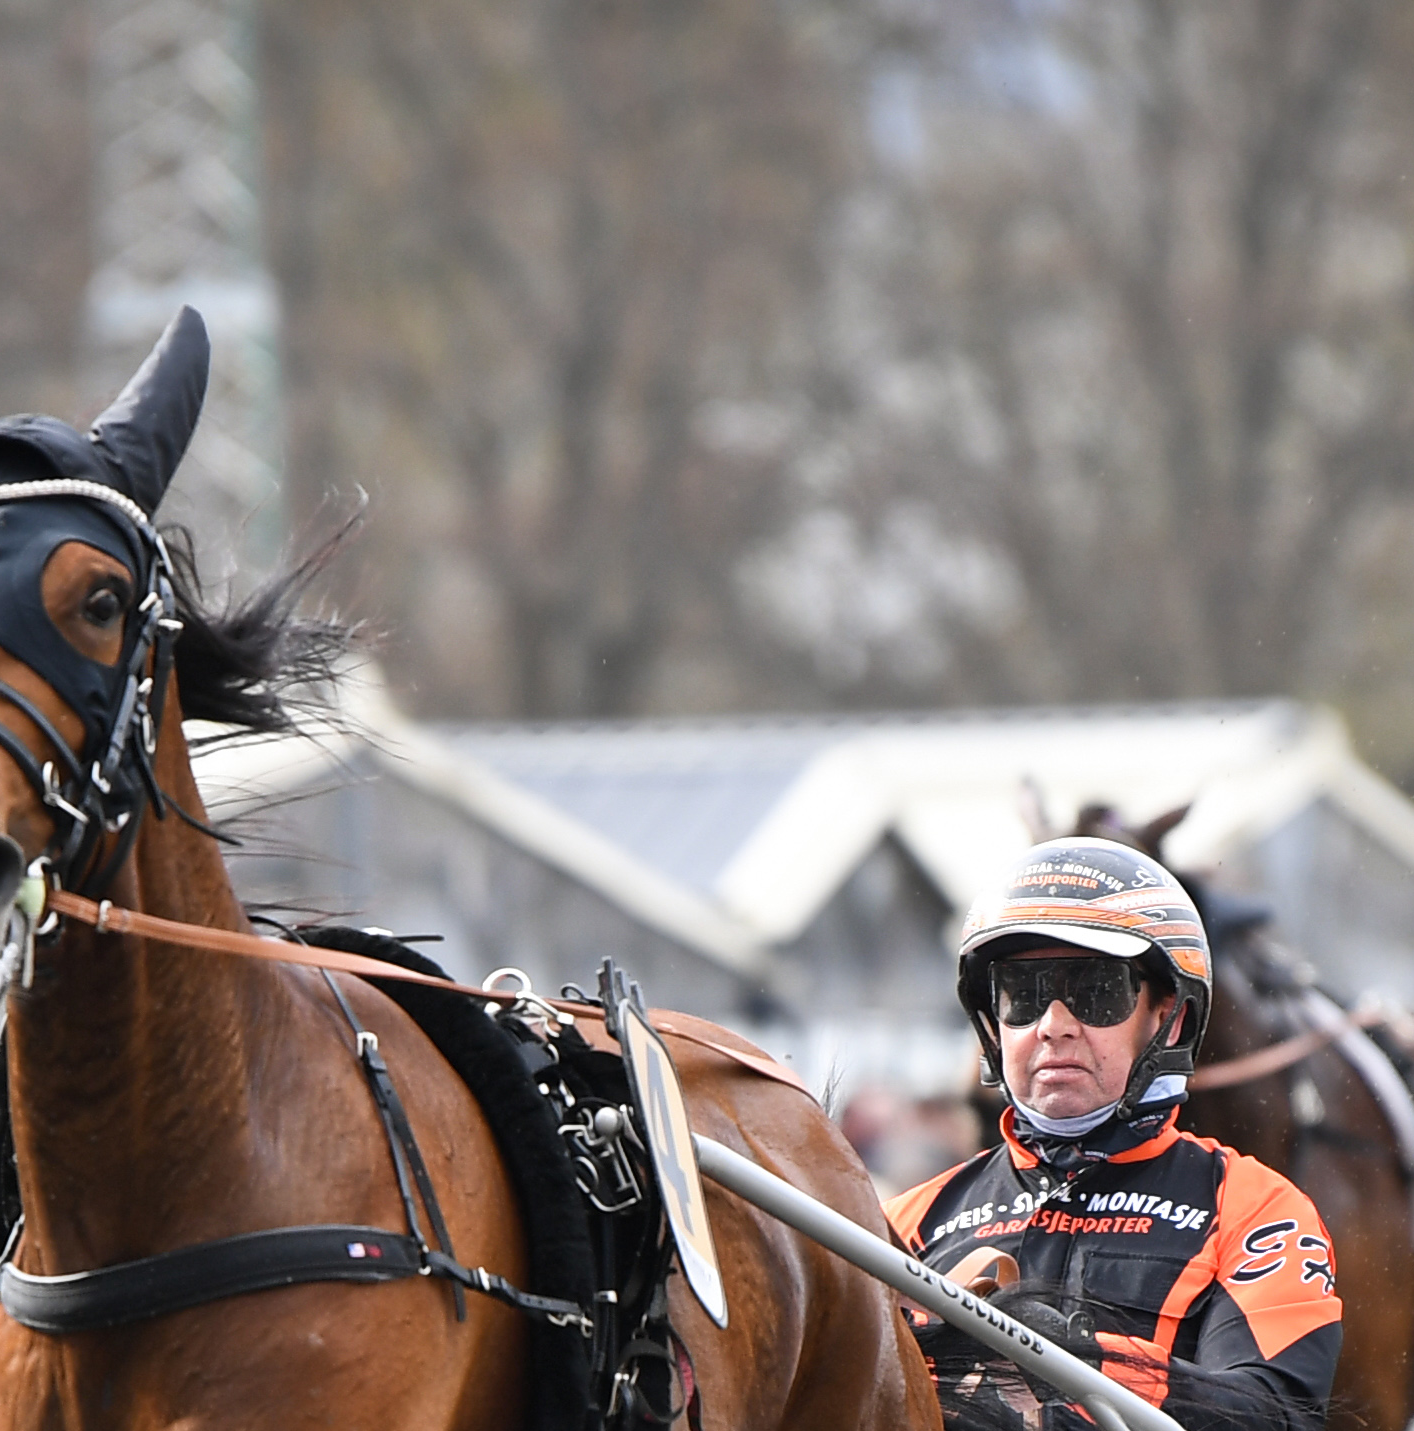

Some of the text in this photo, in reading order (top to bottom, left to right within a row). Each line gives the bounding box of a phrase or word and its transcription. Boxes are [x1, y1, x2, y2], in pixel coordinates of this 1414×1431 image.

[1062, 863, 1125, 892] MONTASJE
[646, 1041, 695, 1237] 4
[932, 1202, 994, 1241] SVEIS
[1086, 1192, 1210, 1230] MONTASJE
[974, 1208, 1153, 1239] GARASJEPORTER
